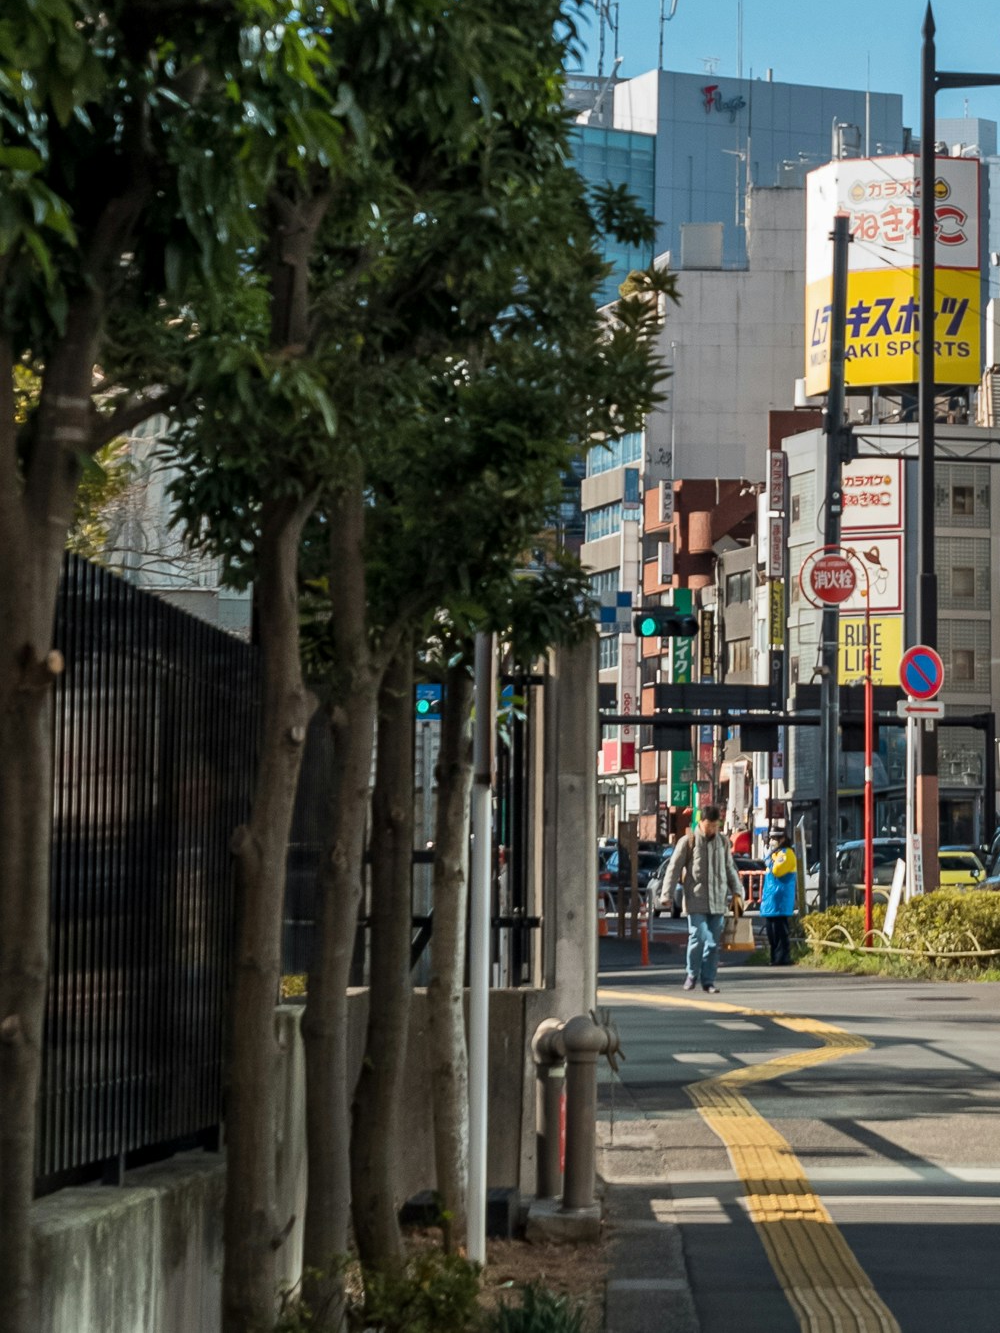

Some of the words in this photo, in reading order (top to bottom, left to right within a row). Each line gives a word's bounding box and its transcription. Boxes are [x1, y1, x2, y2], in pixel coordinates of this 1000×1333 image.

[845, 475, 884, 487] カラオケ
[814, 569, 854, 589] 消火栓
[673, 790, 687, 802] 2F
